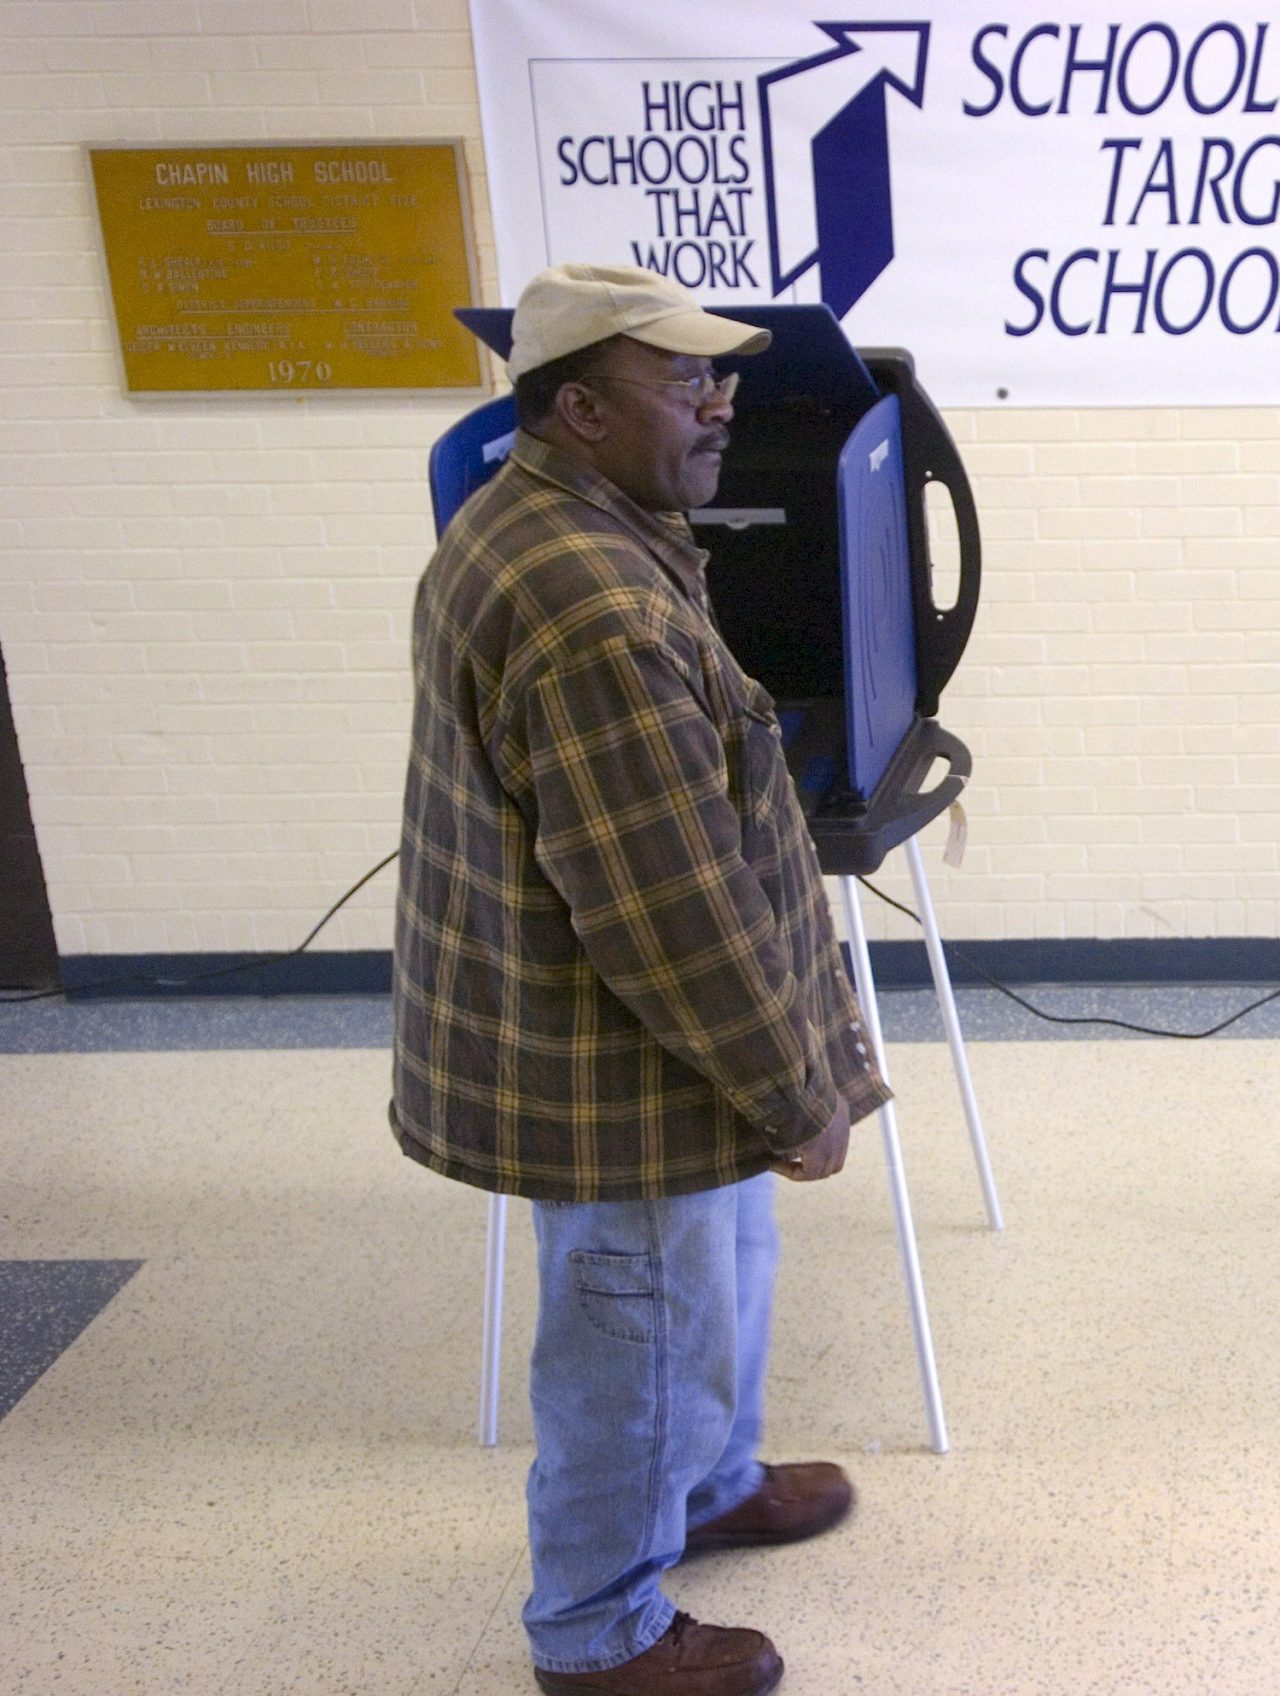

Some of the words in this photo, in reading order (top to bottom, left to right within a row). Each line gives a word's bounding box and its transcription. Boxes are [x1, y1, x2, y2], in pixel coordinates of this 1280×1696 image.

[963, 22, 1277, 117] SCHOOL
[642, 81, 745, 132] HIGH
[155, 163, 229, 185] CHAPIN
[246, 162, 293, 184] HIGH
[314, 161, 393, 184] SCHOOL
[557, 135, 749, 186] SCHOOLS
[212, 196, 259, 209] COUNTY
[645, 188, 752, 237] THAT
[631, 240, 758, 288] WORK
[268, 360, 331, 384] 1970
